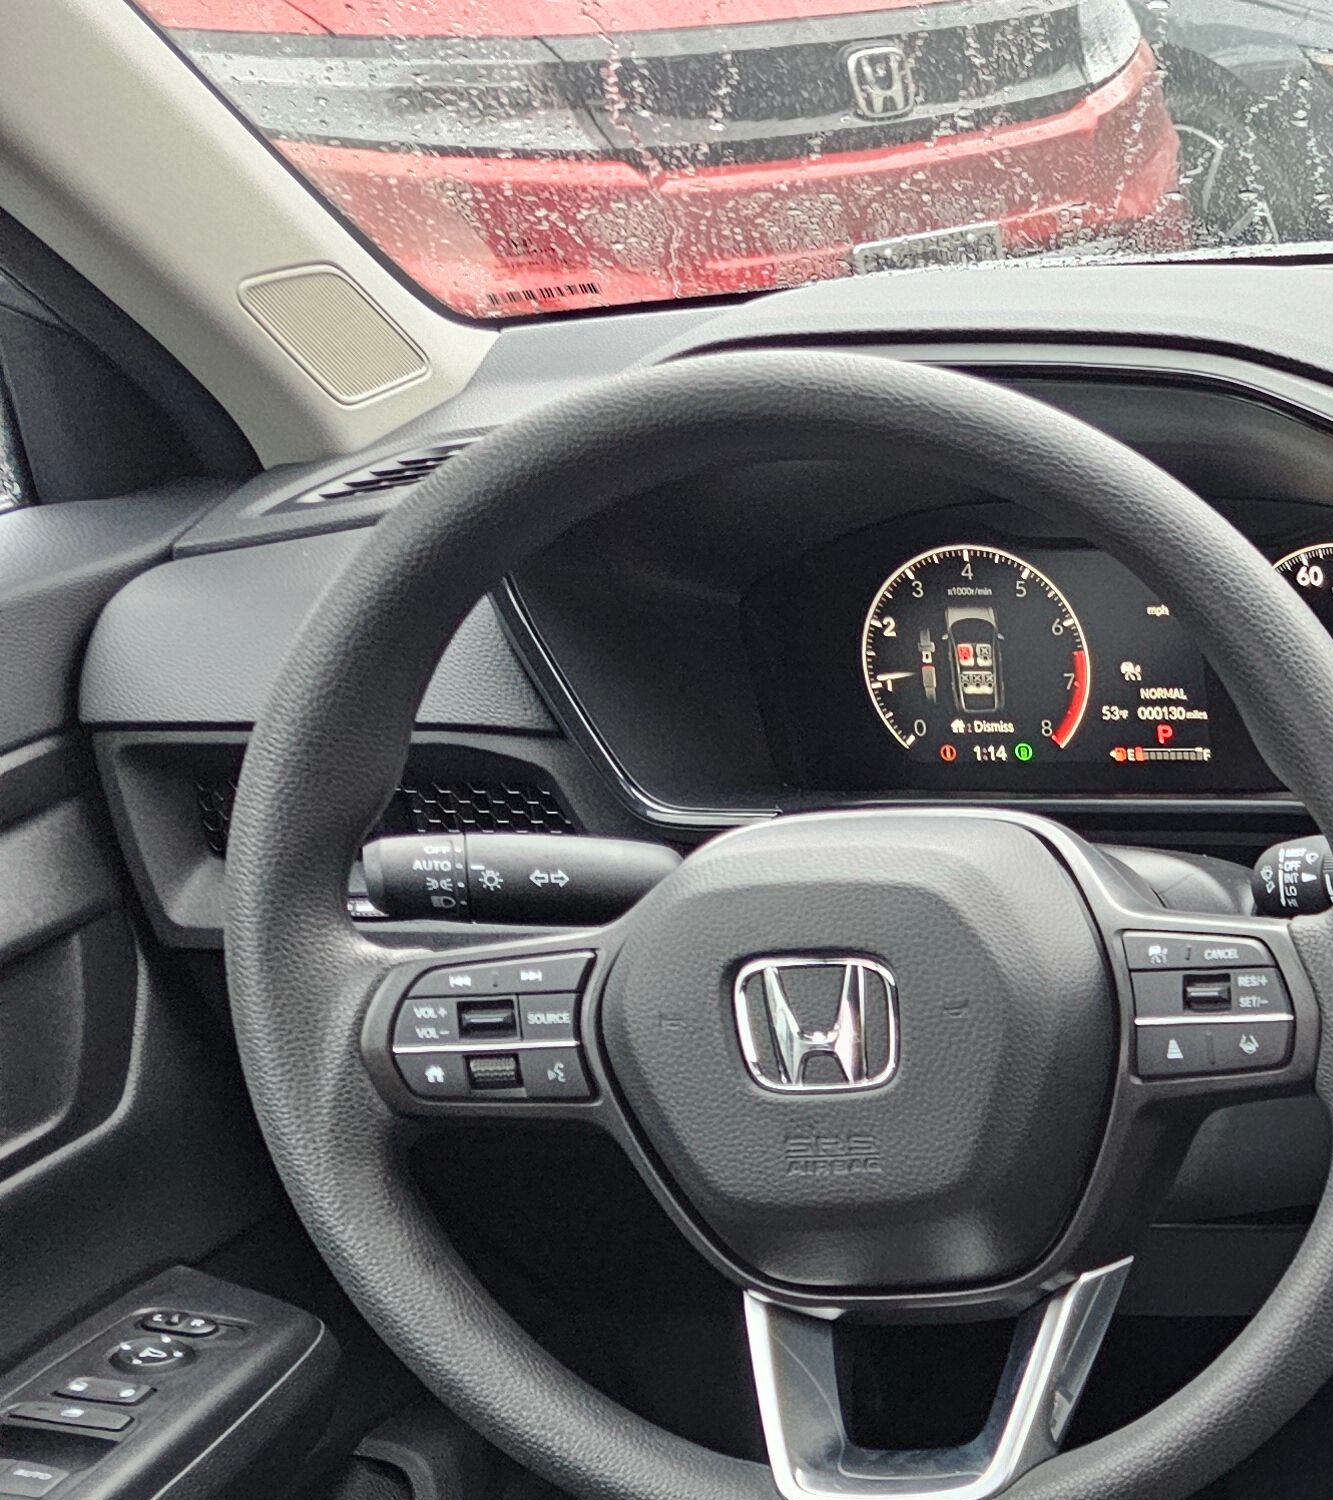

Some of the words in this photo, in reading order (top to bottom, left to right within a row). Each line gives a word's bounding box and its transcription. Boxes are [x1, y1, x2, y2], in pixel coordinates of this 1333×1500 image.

[961, 563, 974, 580] 4
[1296, 566, 1324, 587] 60
[911, 582, 924, 598] 3
[1015, 582, 1027, 598] 5
[1147, 605, 1170, 617] mph
[882, 617, 897, 637] 2
[1051, 619, 1064, 636] 6
[1063, 673, 1076, 690] 7
[1140, 688, 1188, 700] NORMAL
[1137, 706, 1186, 720] 000130
[914, 719, 927, 737] 0
[973, 720, 1015, 734] Dismiss
[1041, 719, 1053, 737] 8
[1157, 723, 1173, 744] P
[973, 745, 1008, 761] 1:14
[412, 859, 452, 872] AUTO
[1284, 860, 1301, 871] OFF
[1284, 873, 1299, 884] INT
[1285, 886, 1298, 897] LO
[1204, 948, 1239, 960] CANCEL
[527, 1012, 571, 1025] SOURCE
